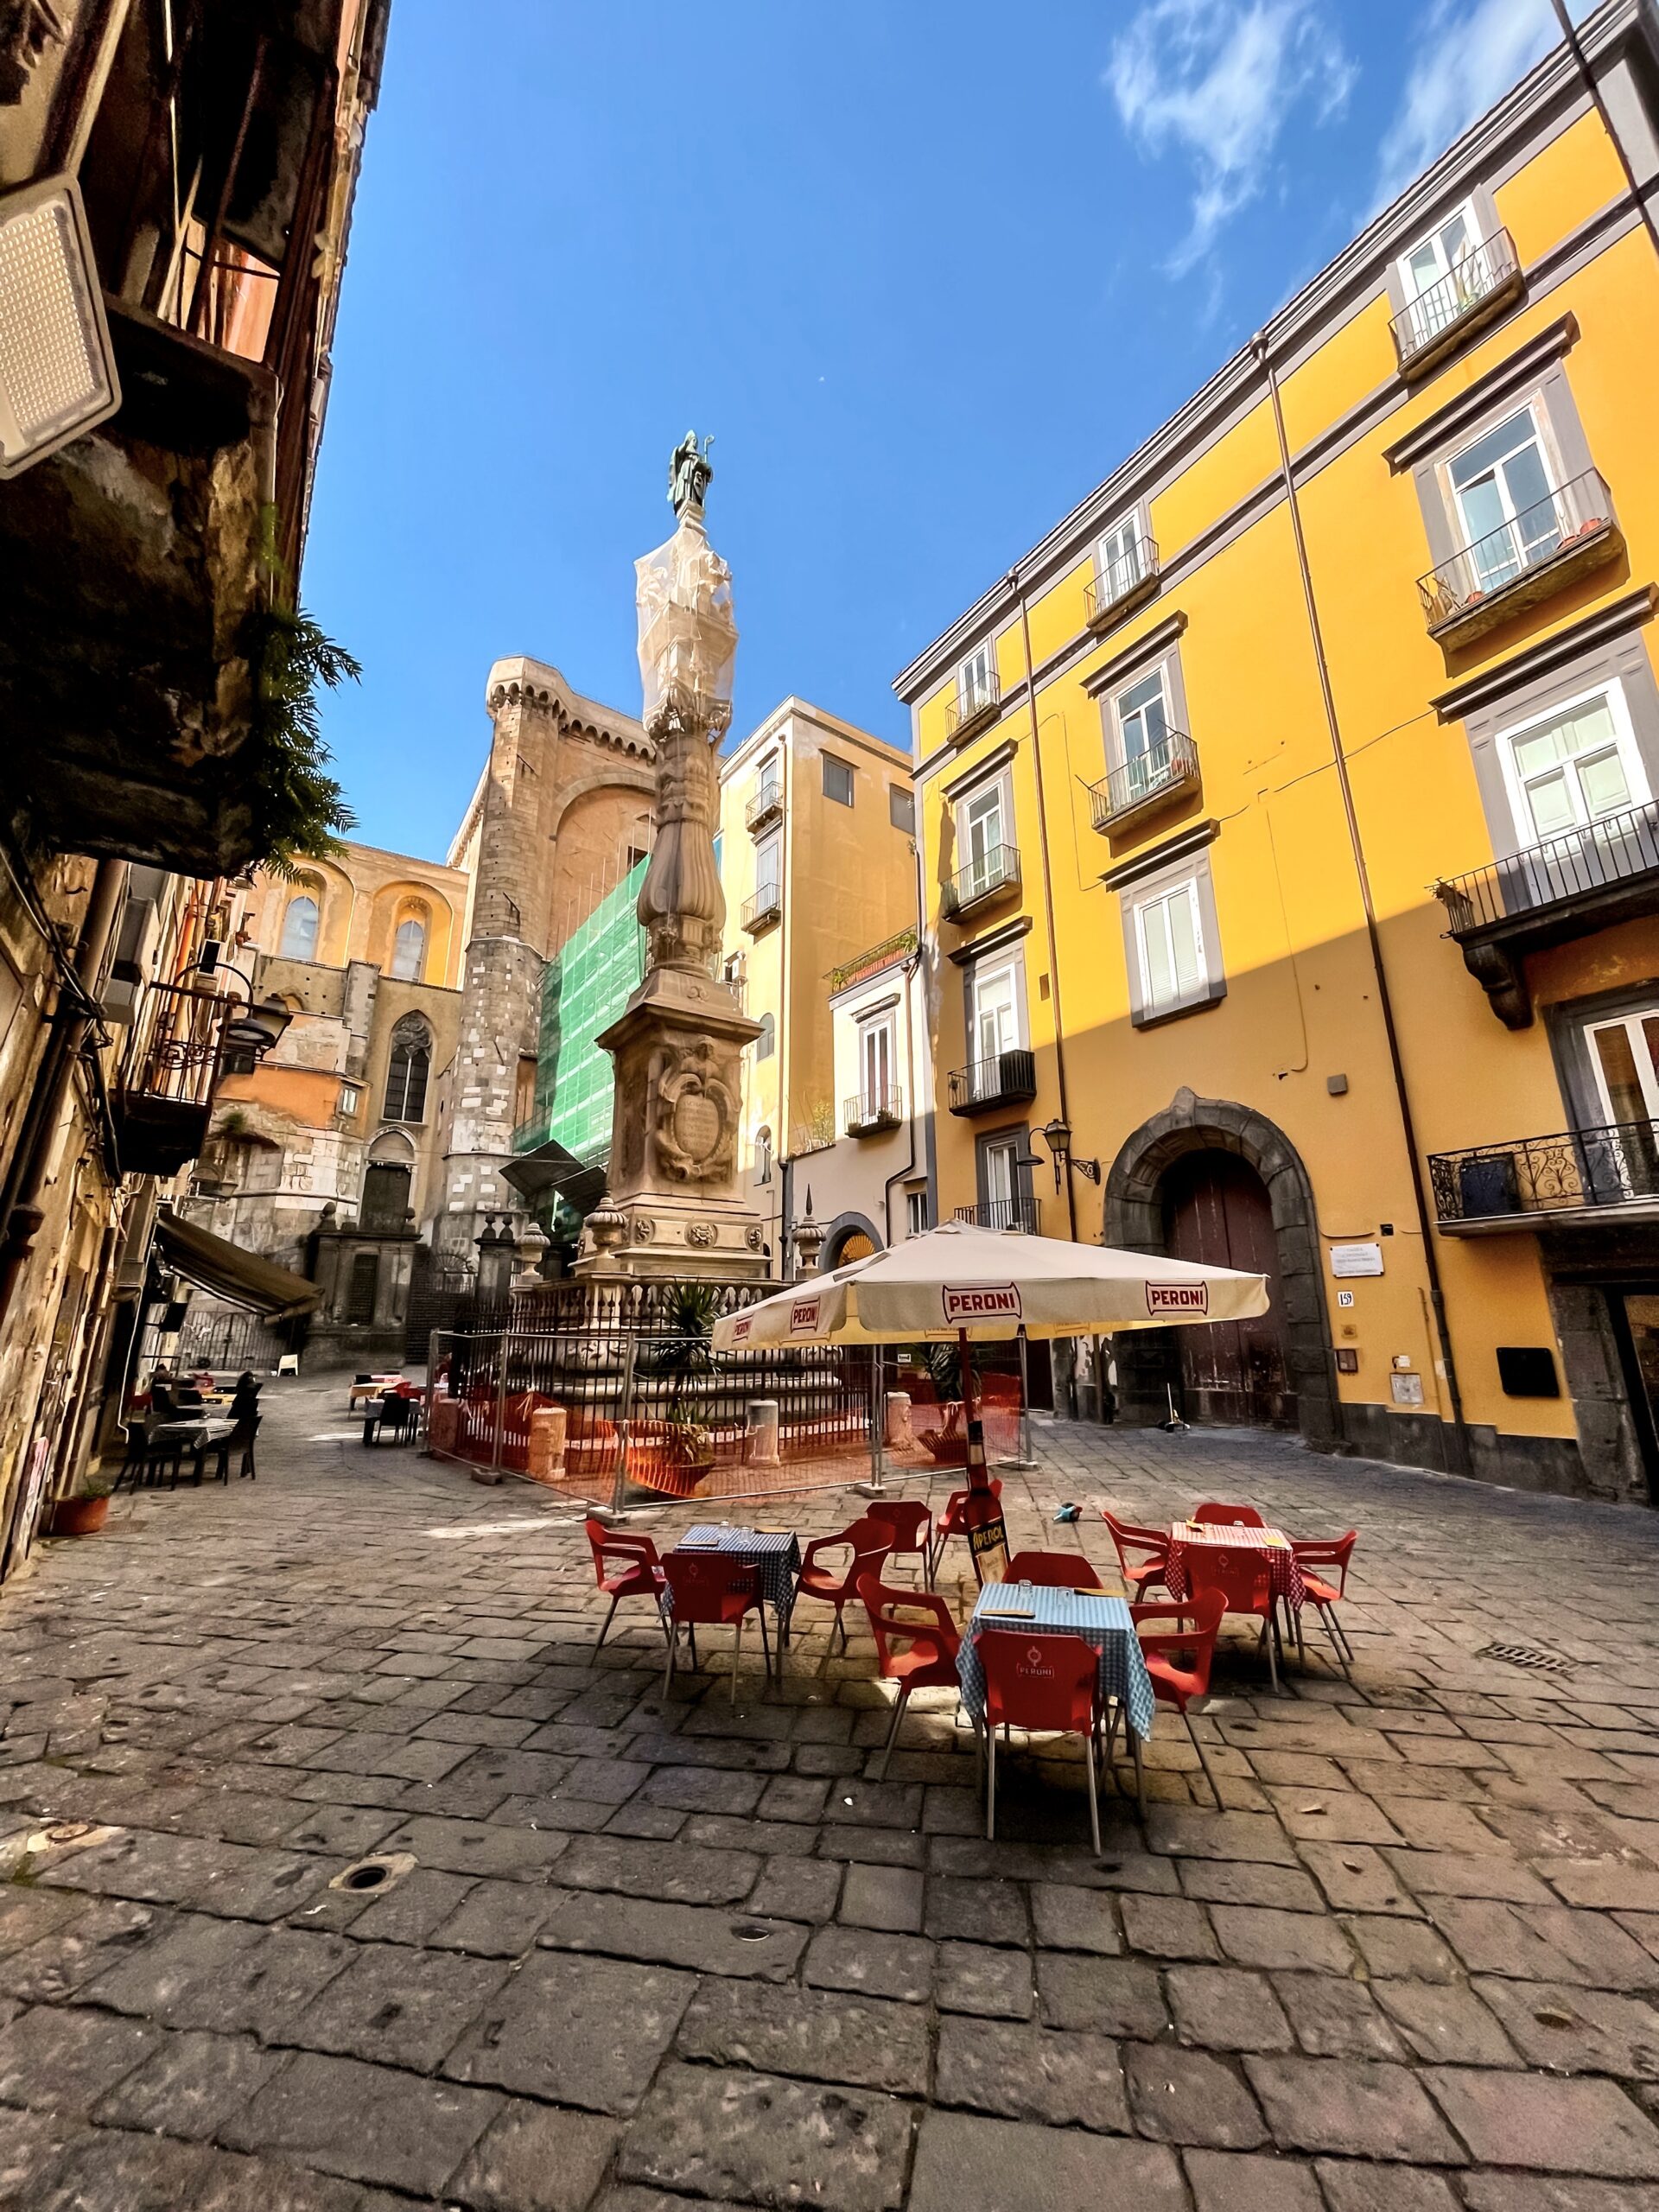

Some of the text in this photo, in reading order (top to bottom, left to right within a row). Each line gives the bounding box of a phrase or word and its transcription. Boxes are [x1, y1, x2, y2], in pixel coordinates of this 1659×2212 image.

[949, 1293, 1015, 1312] PERONI
[1151, 1290, 1203, 1306] PERONI
[1340, 1293, 1352, 1305] 159
[793, 1306, 818, 1324] PERONI
[973, 1525, 1004, 1550] APEROL
[1020, 1667, 1052, 1675] PERONI
